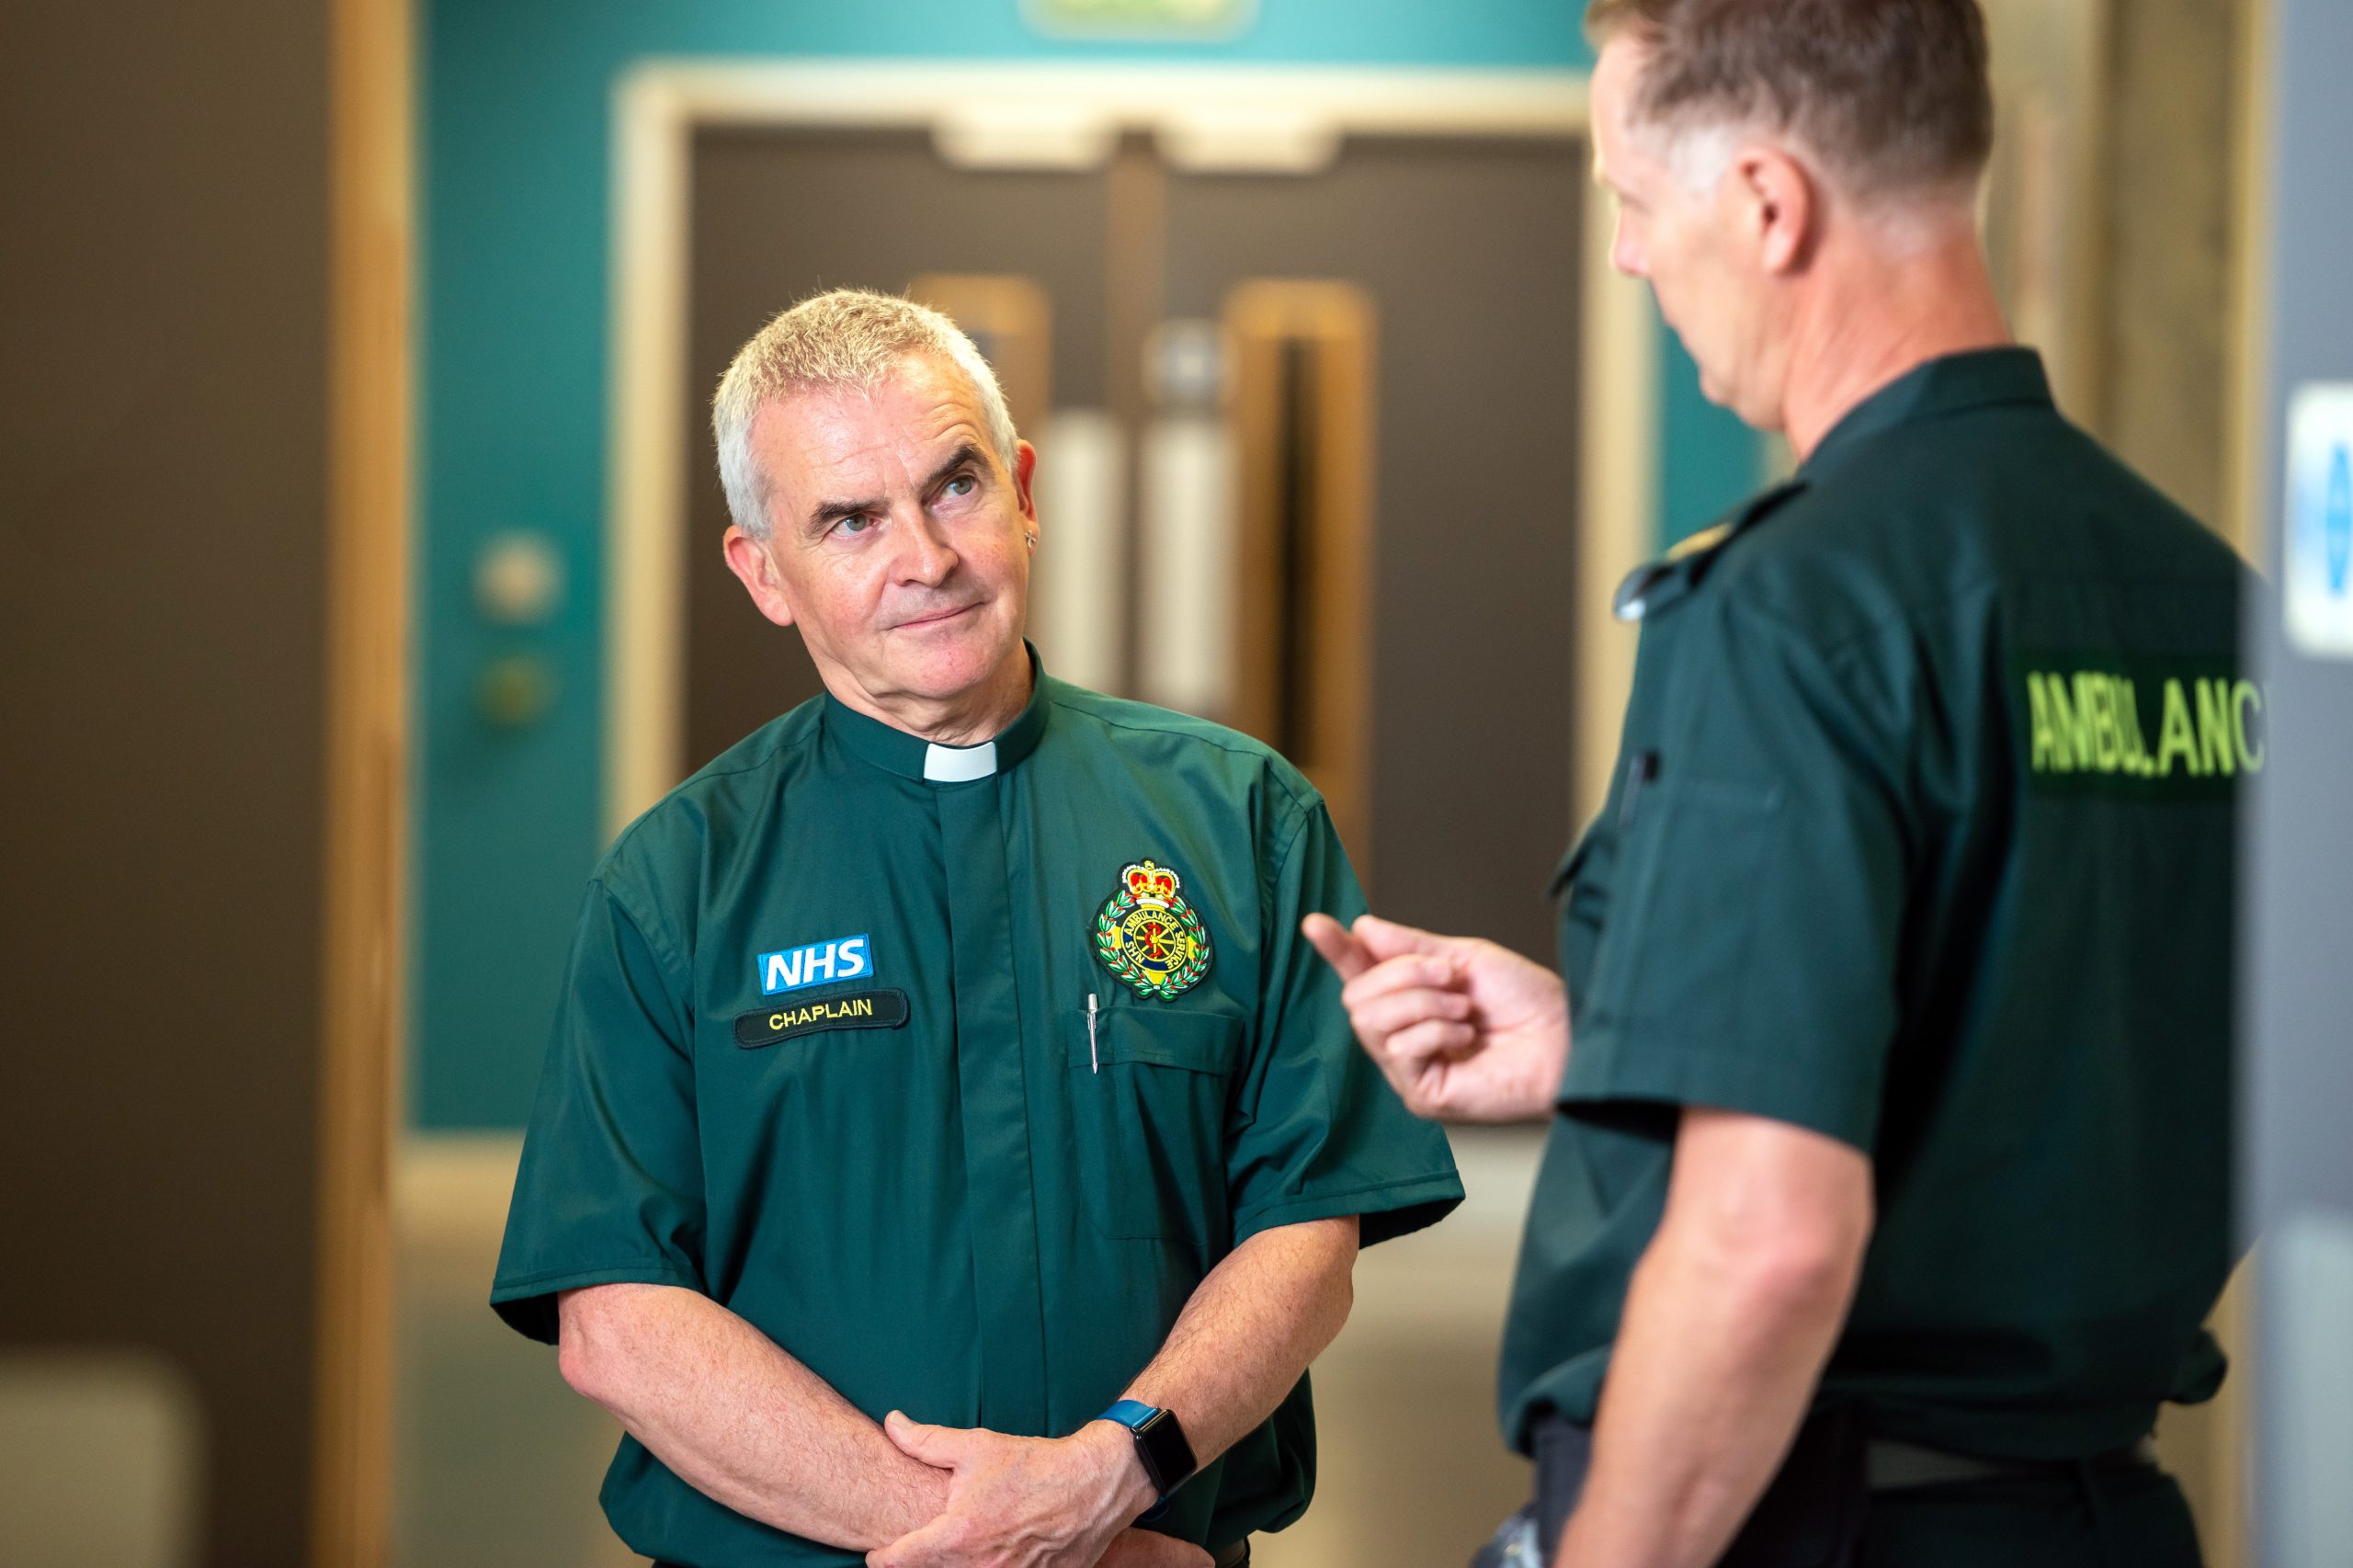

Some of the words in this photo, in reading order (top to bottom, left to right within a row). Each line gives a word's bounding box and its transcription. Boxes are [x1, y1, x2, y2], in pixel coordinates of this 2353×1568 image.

[2027, 671, 2268, 777] AMBULANC
[1123, 910, 1179, 937] AMBULANCE
[766, 938, 866, 991] NHS
[1125, 940, 1145, 964] NHS
[1165, 930, 1187, 970] SERVICE
[768, 998, 873, 1031] CHAPLAIN
